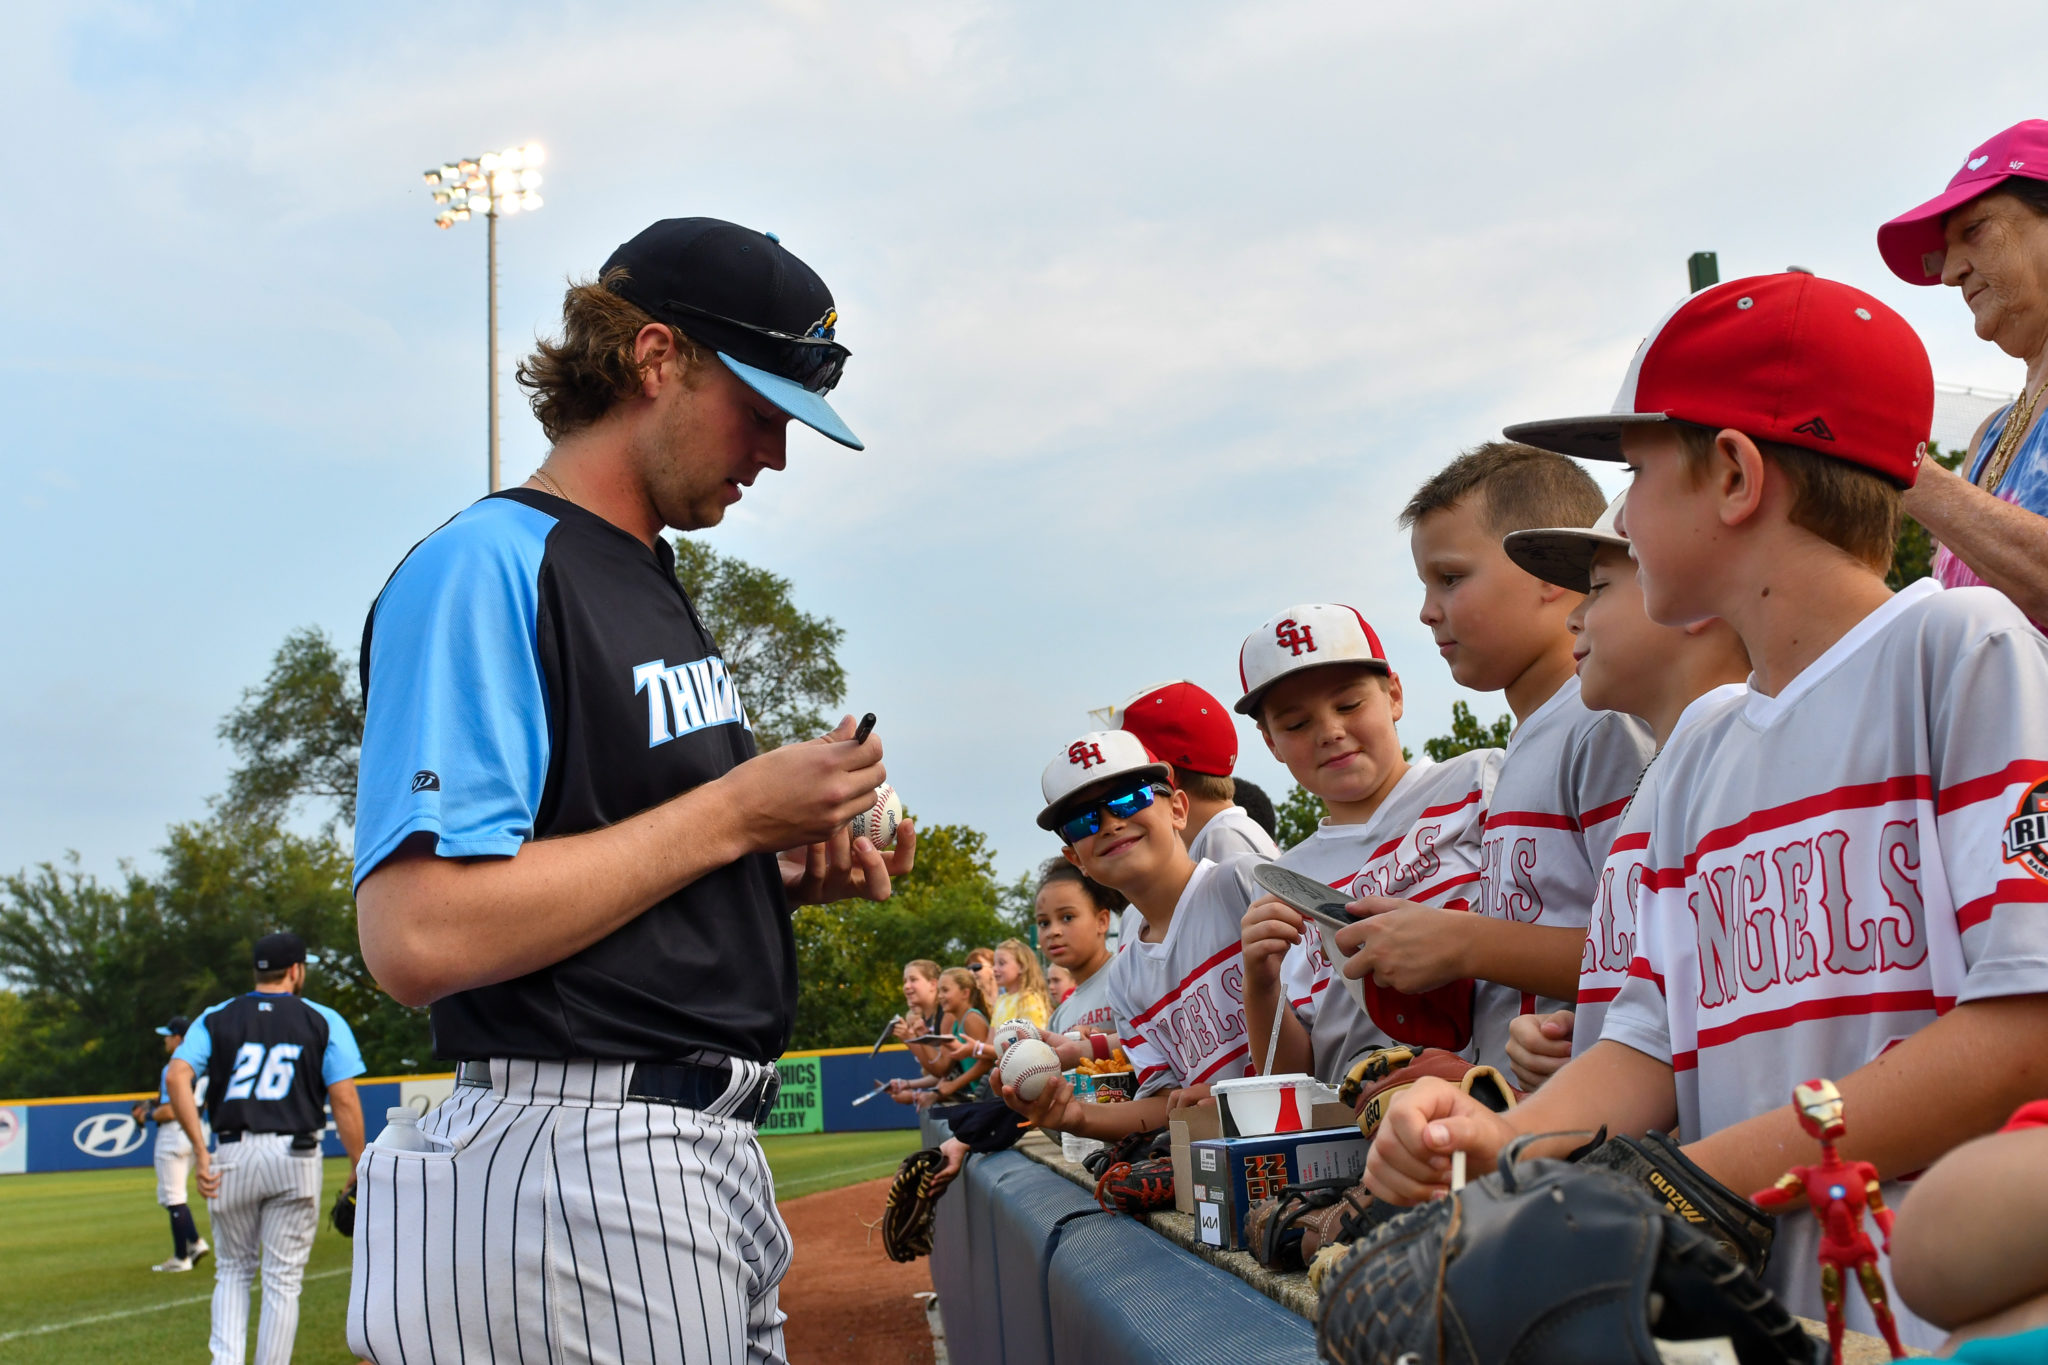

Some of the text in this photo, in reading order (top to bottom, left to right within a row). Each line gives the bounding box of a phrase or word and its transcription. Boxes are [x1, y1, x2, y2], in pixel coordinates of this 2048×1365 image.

[2014, 815, 2048, 846] RI
[1687, 818, 1929, 1009] NGELS
[1077, 1006, 1112, 1026] EART
[223, 1041, 304, 1103] 26
[779, 1063, 817, 1086] HICS
